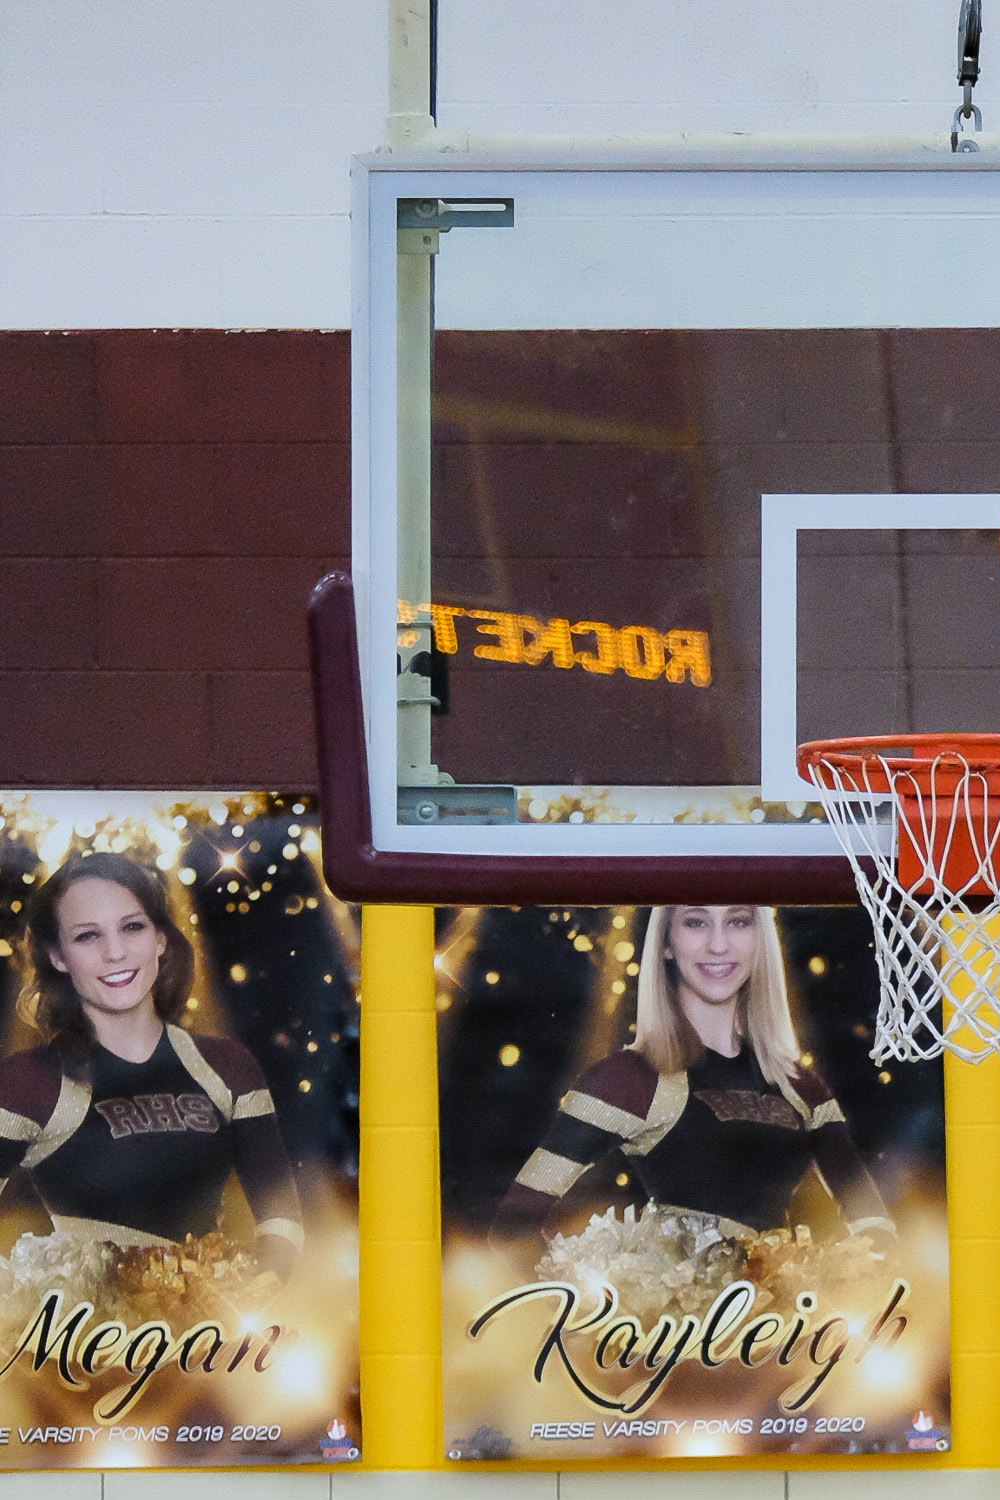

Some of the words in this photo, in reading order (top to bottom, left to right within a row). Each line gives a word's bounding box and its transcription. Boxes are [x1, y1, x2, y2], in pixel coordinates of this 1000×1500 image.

[95, 1093, 220, 1140] RHS
[0, 1291, 296, 1421] Megan
[470, 1281, 908, 1414] Kayleigh
[18, 1426, 102, 1443] VARSITY
[107, 1425, 169, 1442] POMS
[175, 1425, 223, 1442] 2019
[230, 1425, 282, 1441] 2020
[530, 1422, 596, 1440] REESE
[602, 1419, 688, 1438] VARSITY
[693, 1418, 754, 1435] POMS
[760, 1418, 808, 1435] 2019
[814, 1416, 866, 1433] 2020
